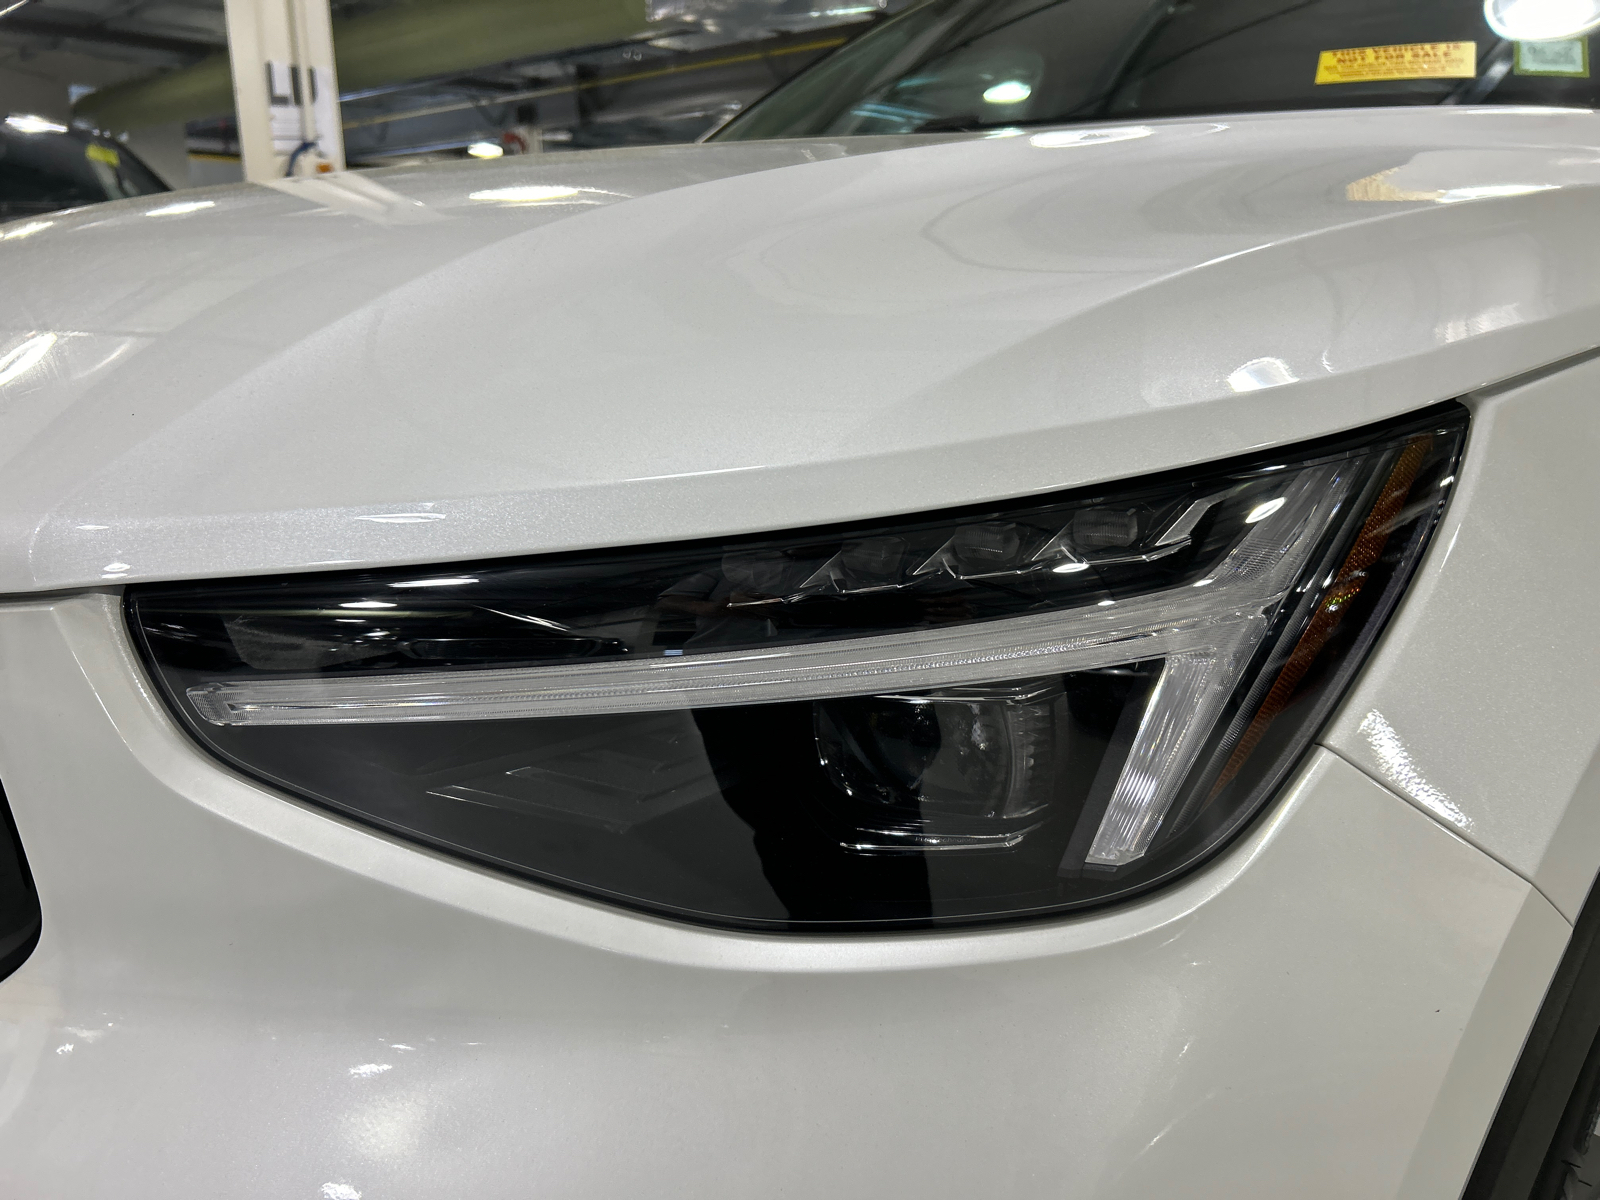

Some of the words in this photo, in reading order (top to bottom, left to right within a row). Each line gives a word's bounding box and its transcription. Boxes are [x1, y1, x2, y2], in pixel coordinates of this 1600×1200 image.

[1336, 55, 1366, 64] NOT
[1374, 52, 1404, 61] FOR
[1411, 50, 1451, 59] SALE
